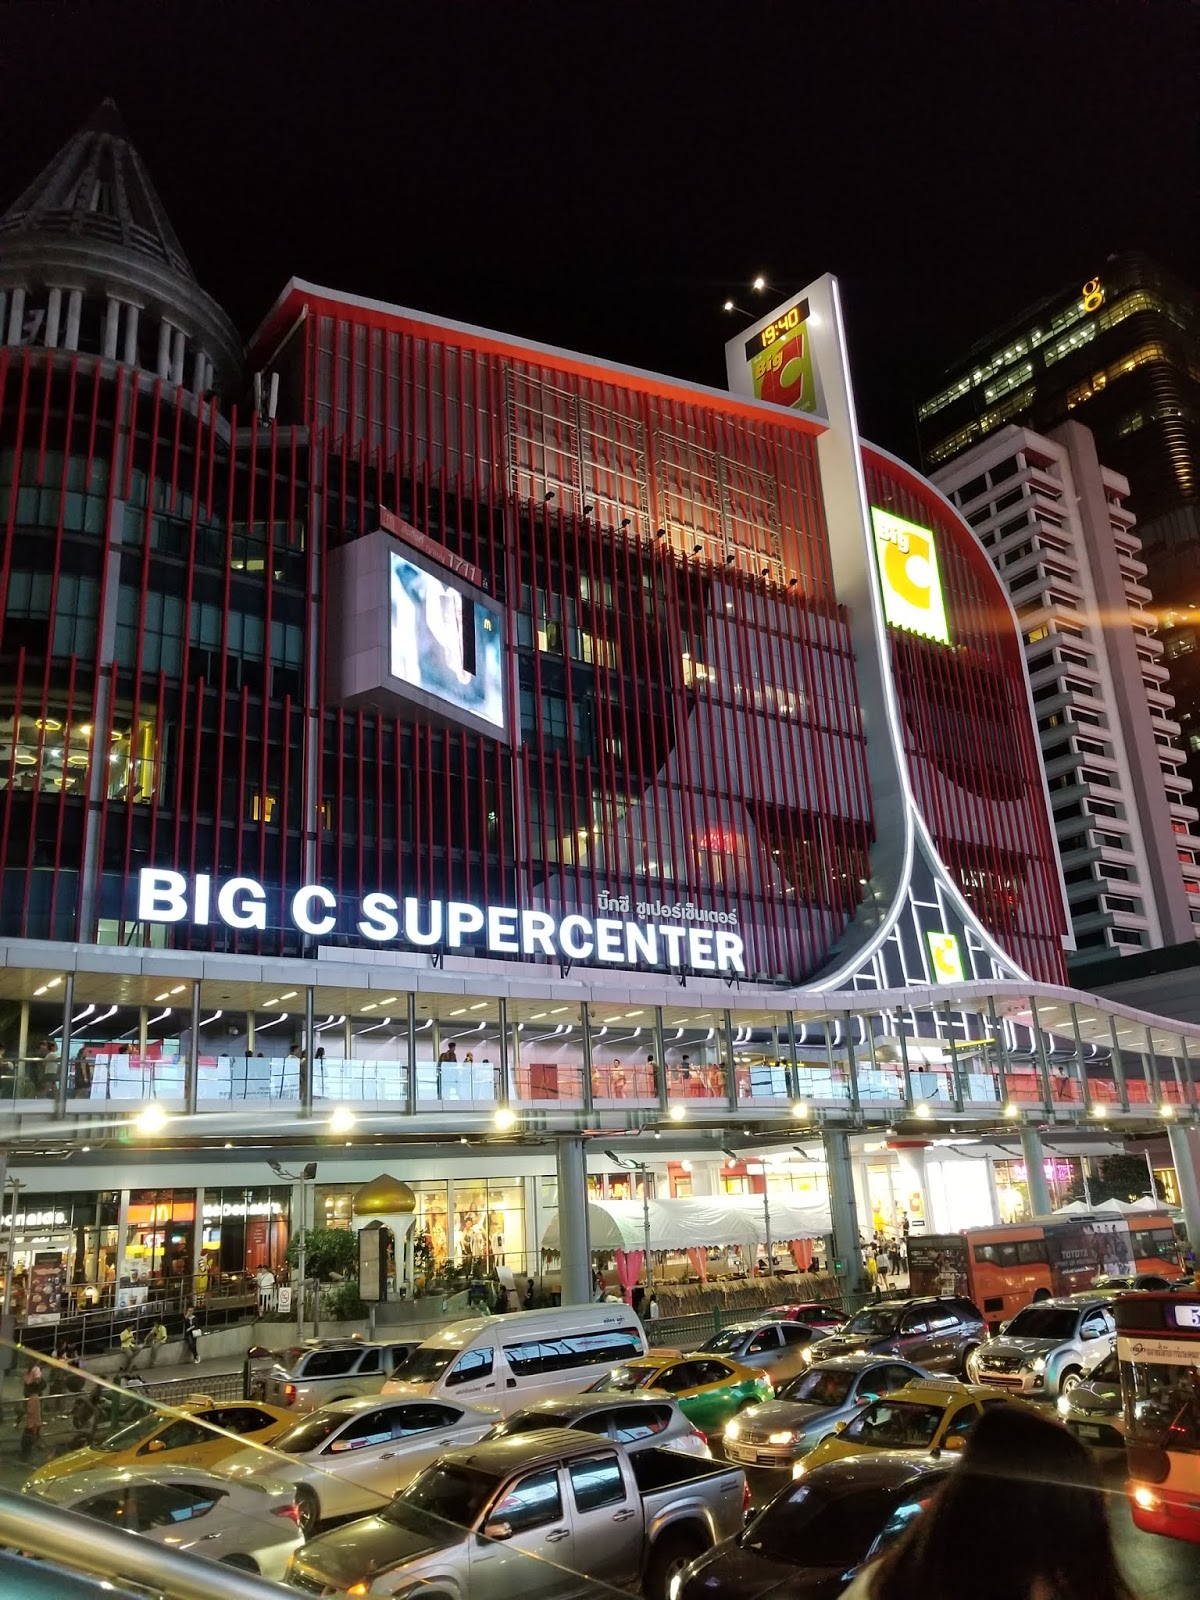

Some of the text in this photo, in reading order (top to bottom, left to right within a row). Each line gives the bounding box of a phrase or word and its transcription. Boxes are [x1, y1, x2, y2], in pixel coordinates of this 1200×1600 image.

[761, 307, 799, 347] 19:40
[755, 350, 784, 380] Big
[760, 332, 805, 408] C
[449, 553, 476, 581] 1711
[884, 531, 930, 610] C
[138, 867, 746, 973] BIG C SUPERCENTER
[597, 889, 738, 925] บิ๊กซี ซูเปอร์เซ็นเตอร์
[1061, 1249, 1089, 1259] TOYOTA
